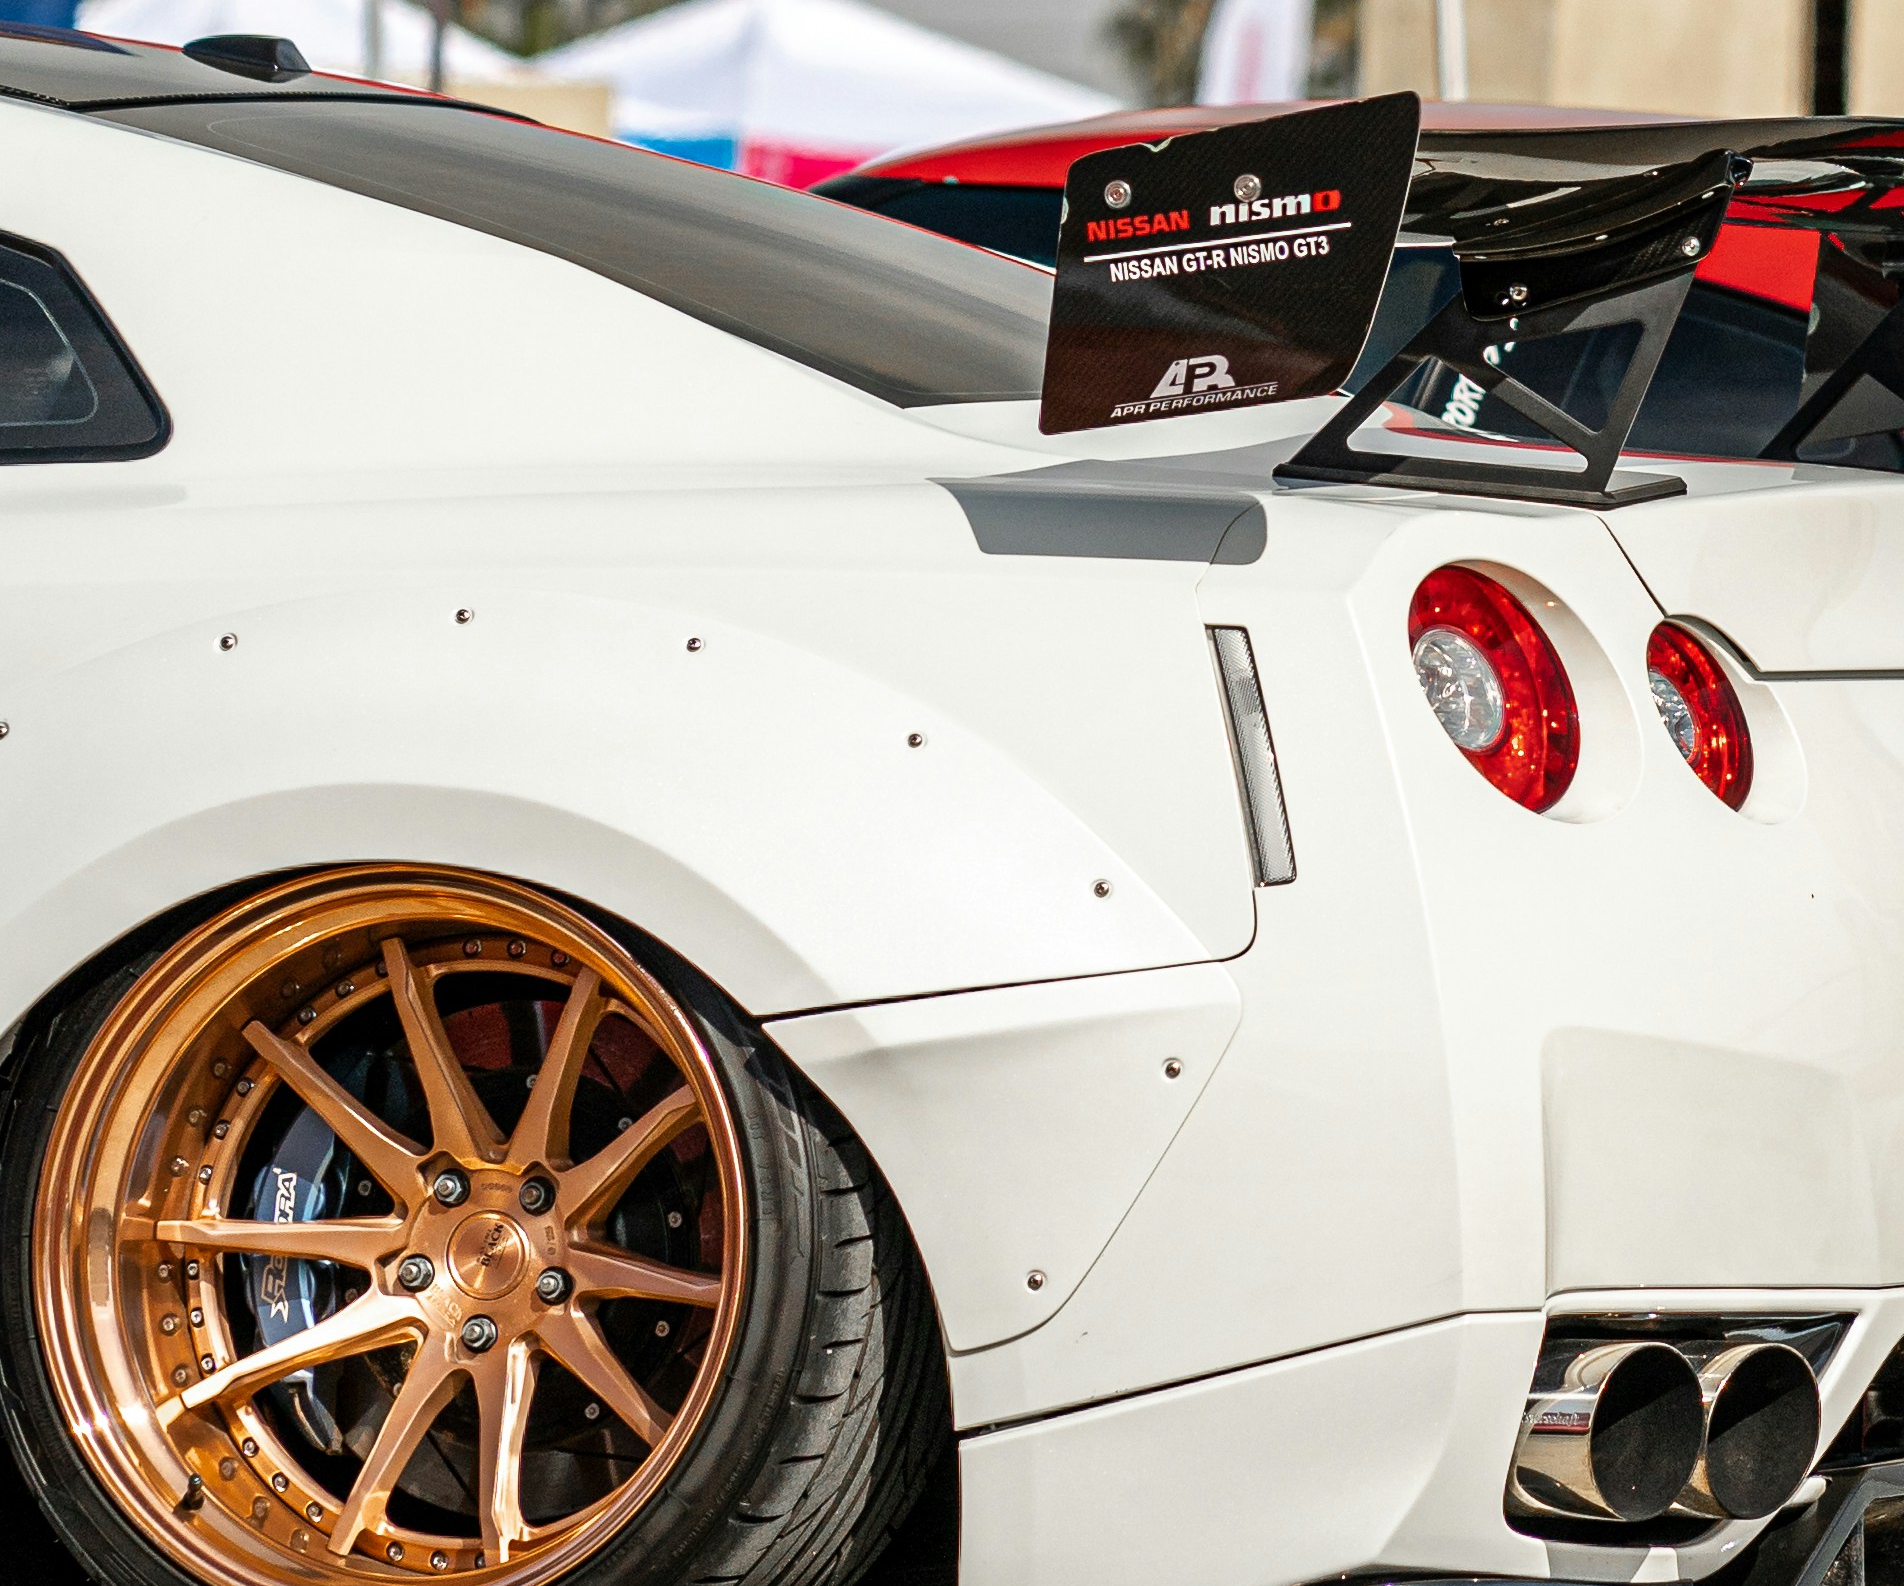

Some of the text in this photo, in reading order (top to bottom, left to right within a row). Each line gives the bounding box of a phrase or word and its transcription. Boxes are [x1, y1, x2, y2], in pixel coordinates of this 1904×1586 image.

[1087, 189, 1341, 242] NISSAN nismo
[1109, 235, 1330, 282] NISSAN GT-R NISMO GT3
[1110, 385, 1278, 418] APR PERFORMANCE
